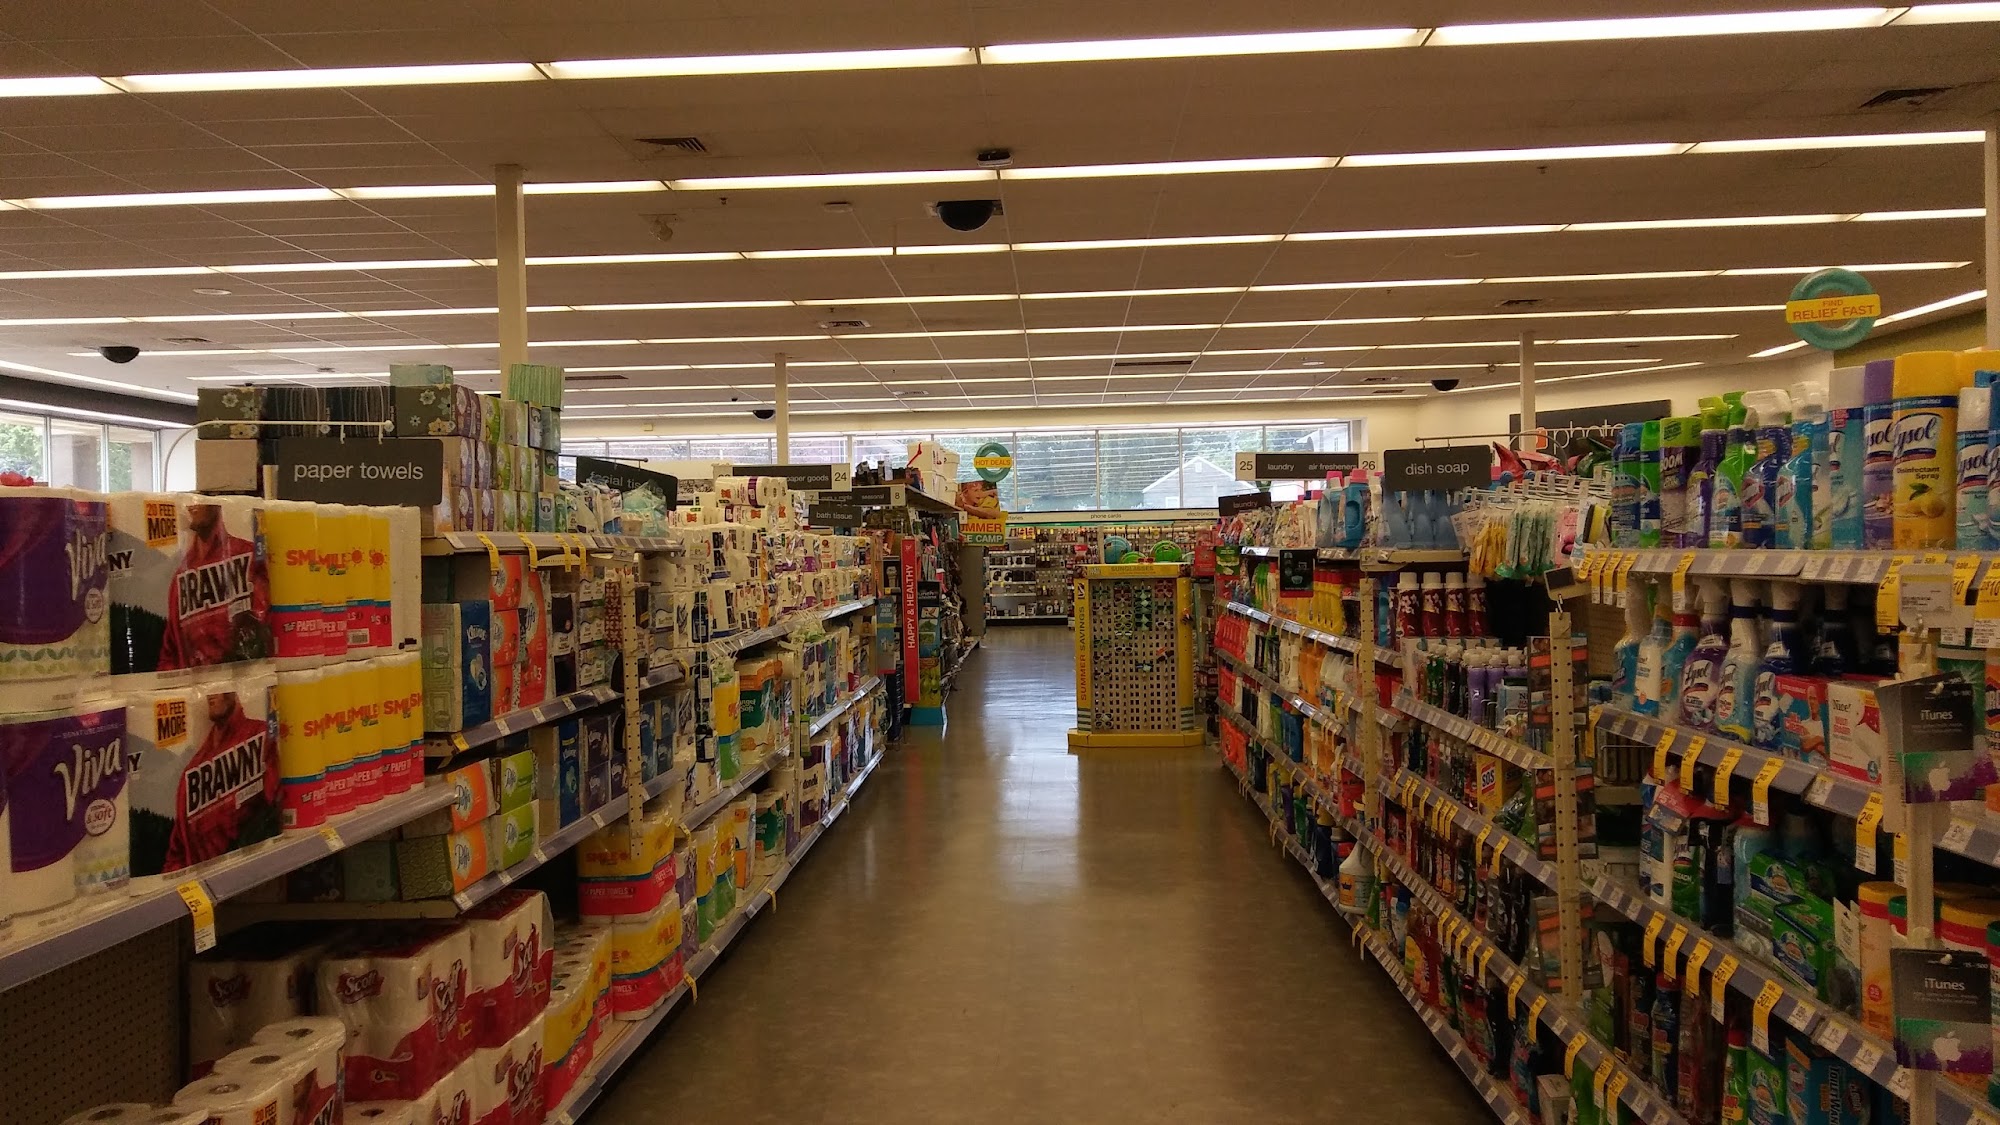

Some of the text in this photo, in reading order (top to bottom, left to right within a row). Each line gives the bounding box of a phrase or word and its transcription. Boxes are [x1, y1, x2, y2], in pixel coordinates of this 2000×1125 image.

[1793, 305, 1875, 320] RELIEF FAST
[294, 462, 424, 483] paper towels
[1239, 460, 1253, 471] 25
[1267, 463, 1295, 472] laundry
[1319, 463, 1357, 471] fresheners
[1362, 460, 1376, 471] 26
[1405, 462, 1470, 477] dish soap
[1897, 466, 1940, 474] Disinfectant
[806, 474, 829, 483] goods
[834, 472, 847, 482] 24
[894, 492, 900, 500] 8
[146, 503, 176, 515] 20 FEET
[1232, 501, 1259, 509] laundry
[833, 512, 853, 520] tissue
[147, 517, 177, 541] MORE
[961, 523, 1002, 532] UMMER
[975, 535, 1003, 543] CAMP
[65, 528, 108, 601] Viva
[178, 556, 250, 617] BRAWNY
[906, 564, 916, 608] HEALTHY
[907, 620, 916, 649] HAPPY
[1077, 606, 1087, 701] SUMMER SAVINGS
[1685, 661, 1710, 687] Lysol
[156, 701, 186, 716] 20 FEET
[1832, 699, 1852, 713] Nice!
[1920, 709, 1953, 721] iTunes
[157, 714, 187, 741] MORE
[54, 737, 122, 822] Viva
[187, 735, 265, 813] BRAWNY
[589, 887, 628, 896] PAPER TOWELS
[344, 969, 378, 996] Scott
[1924, 977, 1966, 991] iTunes
[1829, 1066, 1841, 1101] TOILET
[256, 1101, 277, 1120] 20 FEET
